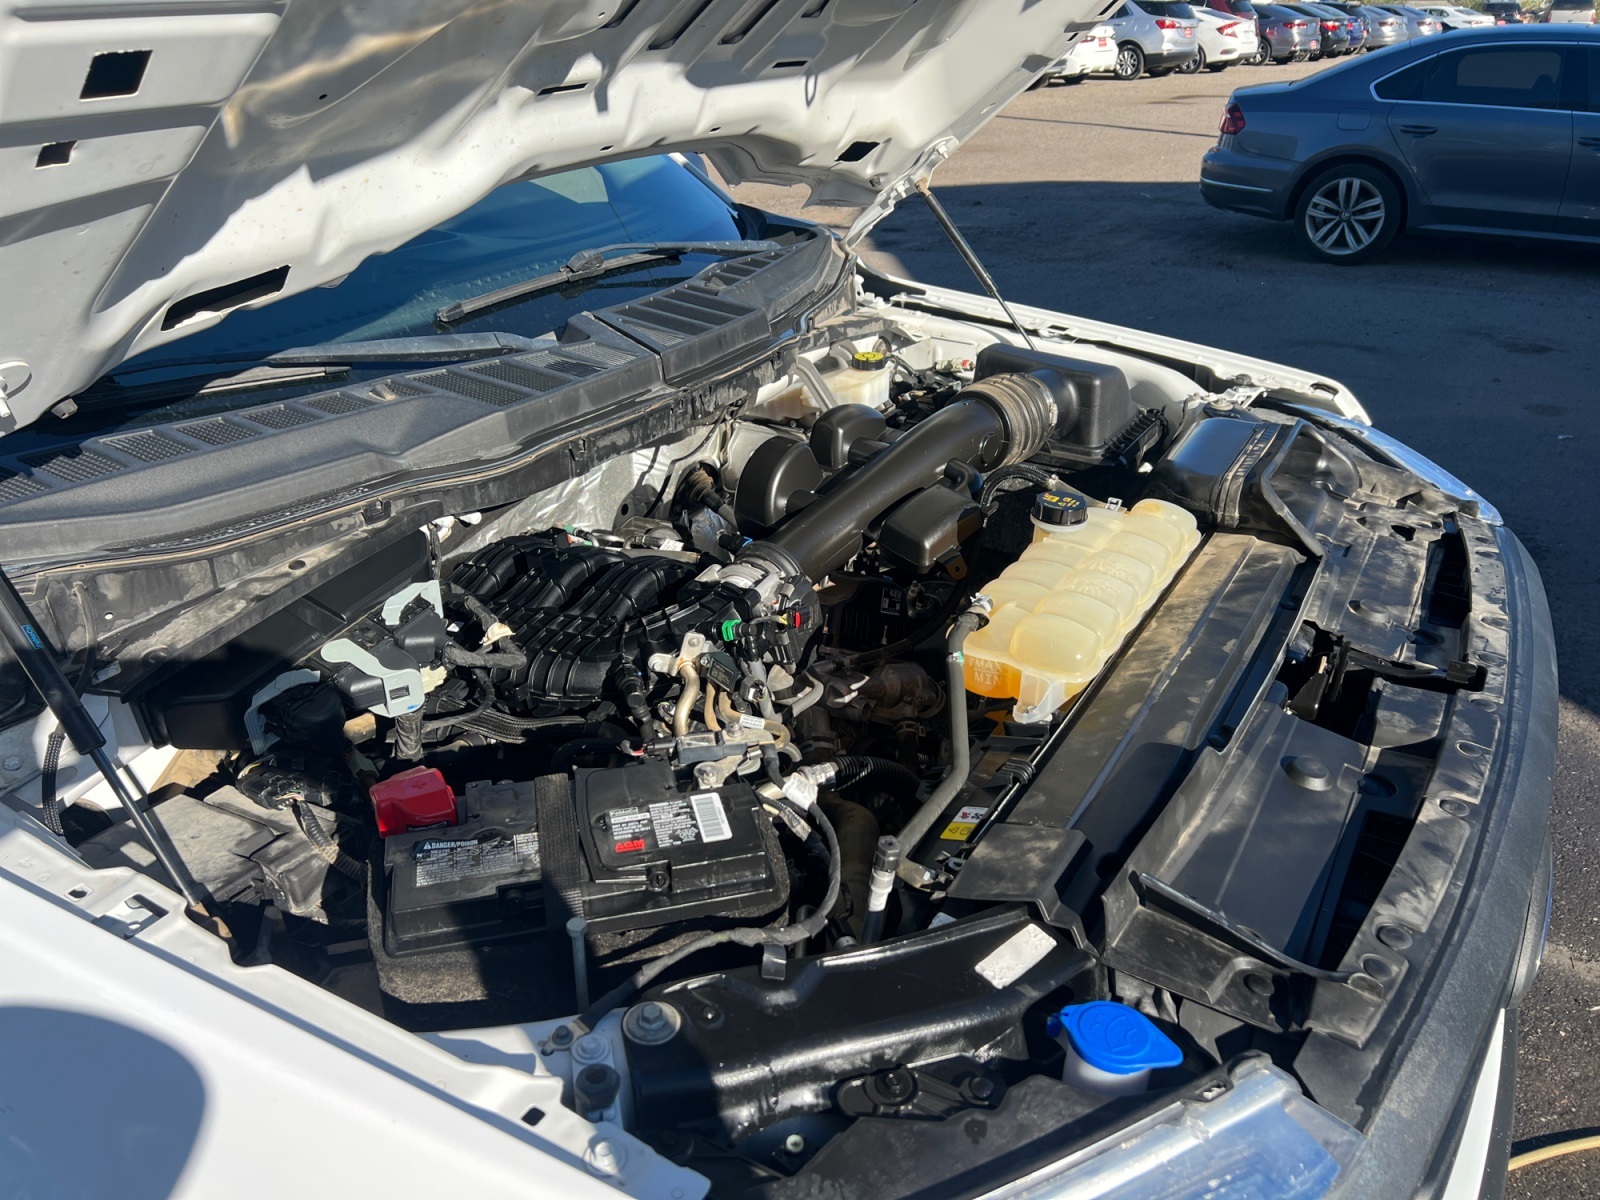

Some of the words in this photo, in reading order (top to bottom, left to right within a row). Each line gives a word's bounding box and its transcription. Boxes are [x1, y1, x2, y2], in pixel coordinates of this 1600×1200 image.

[975, 658, 1002, 672] MAX
[974, 671, 1002, 685] MIN
[431, 839, 478, 849] DANGER/POISON
[615, 839, 645, 852] AGM
